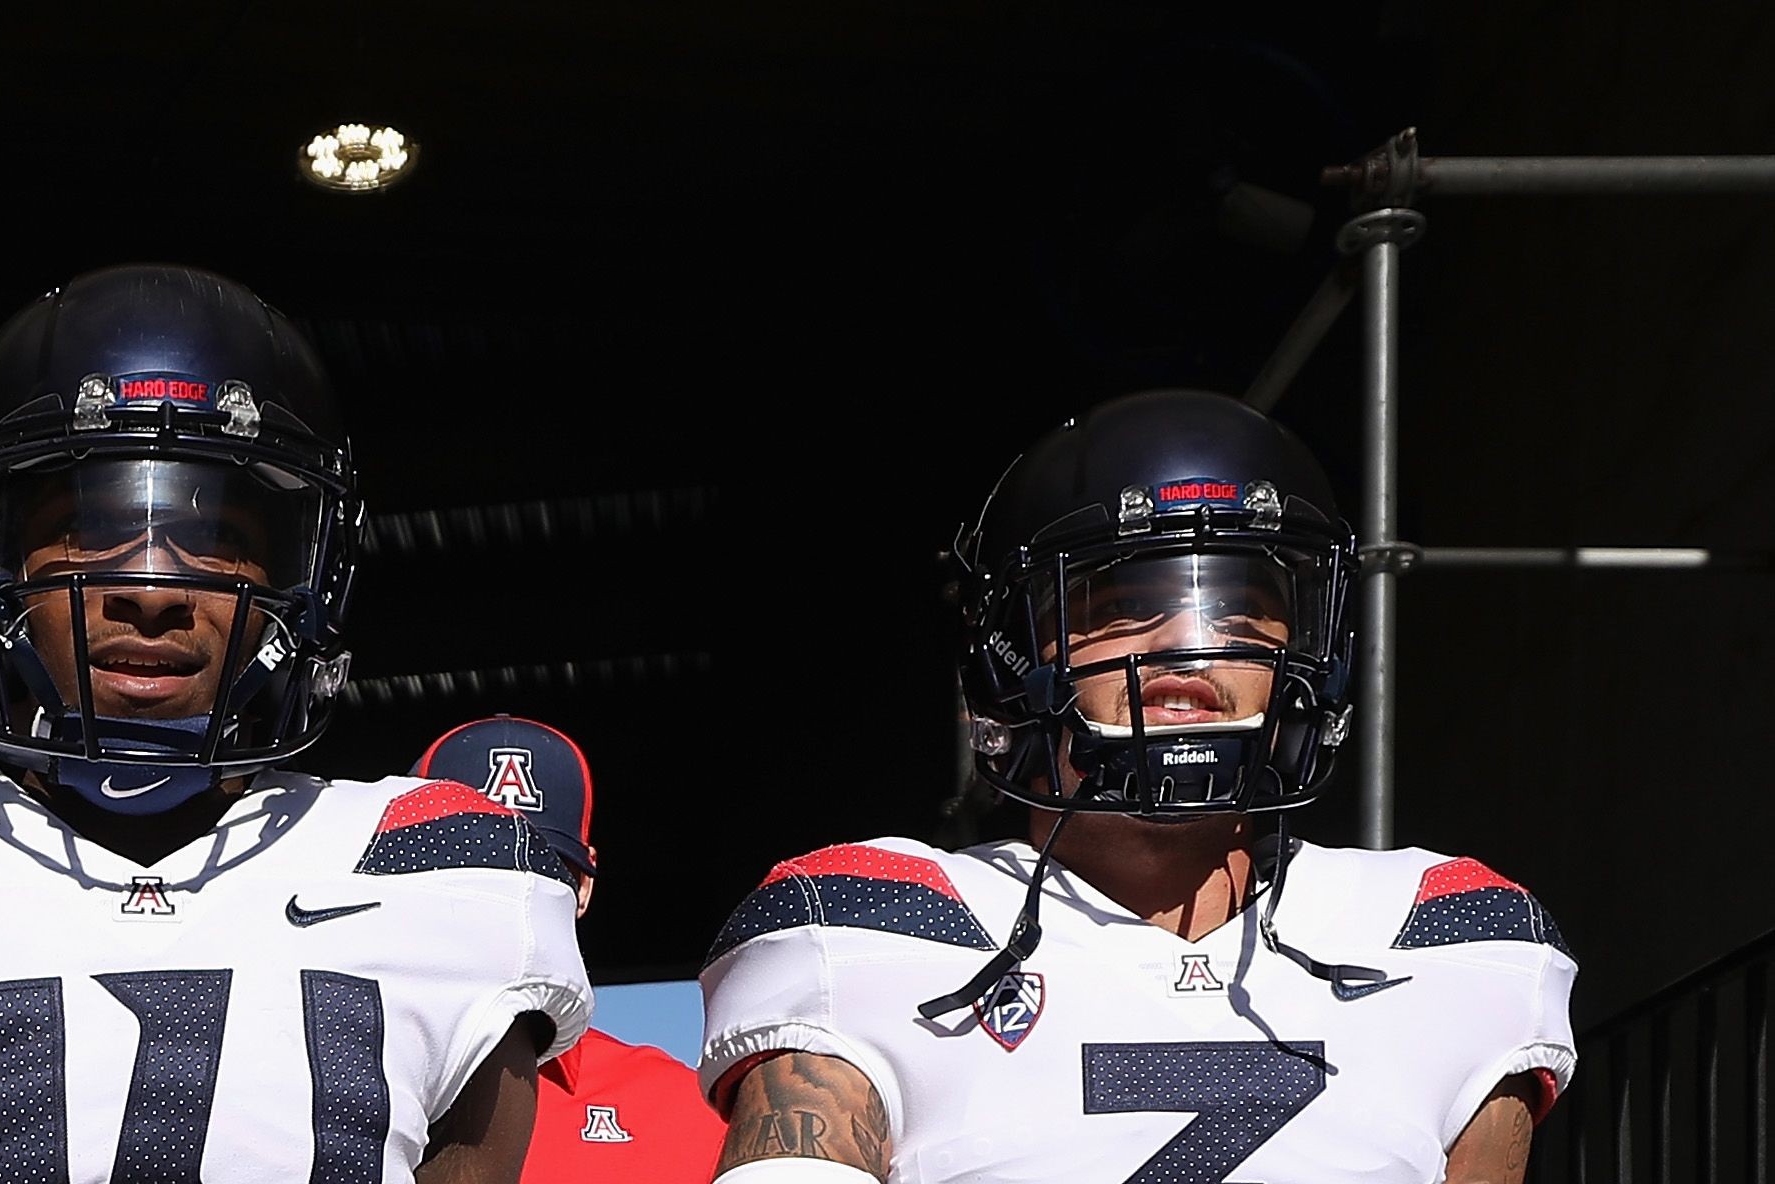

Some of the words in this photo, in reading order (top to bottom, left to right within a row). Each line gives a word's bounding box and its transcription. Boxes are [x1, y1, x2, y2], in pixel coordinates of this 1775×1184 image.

[120, 379, 165, 399] HARD
[168, 381, 208, 401] EDGE
[1159, 483, 1202, 501] HARD
[1203, 483, 1237, 500] EDGE
[477, 747, 543, 811] A
[121, 876, 175, 914] A
[1174, 954, 1223, 992] A
[994, 1002, 1029, 1034] 12
[581, 1105, 629, 1142] A
